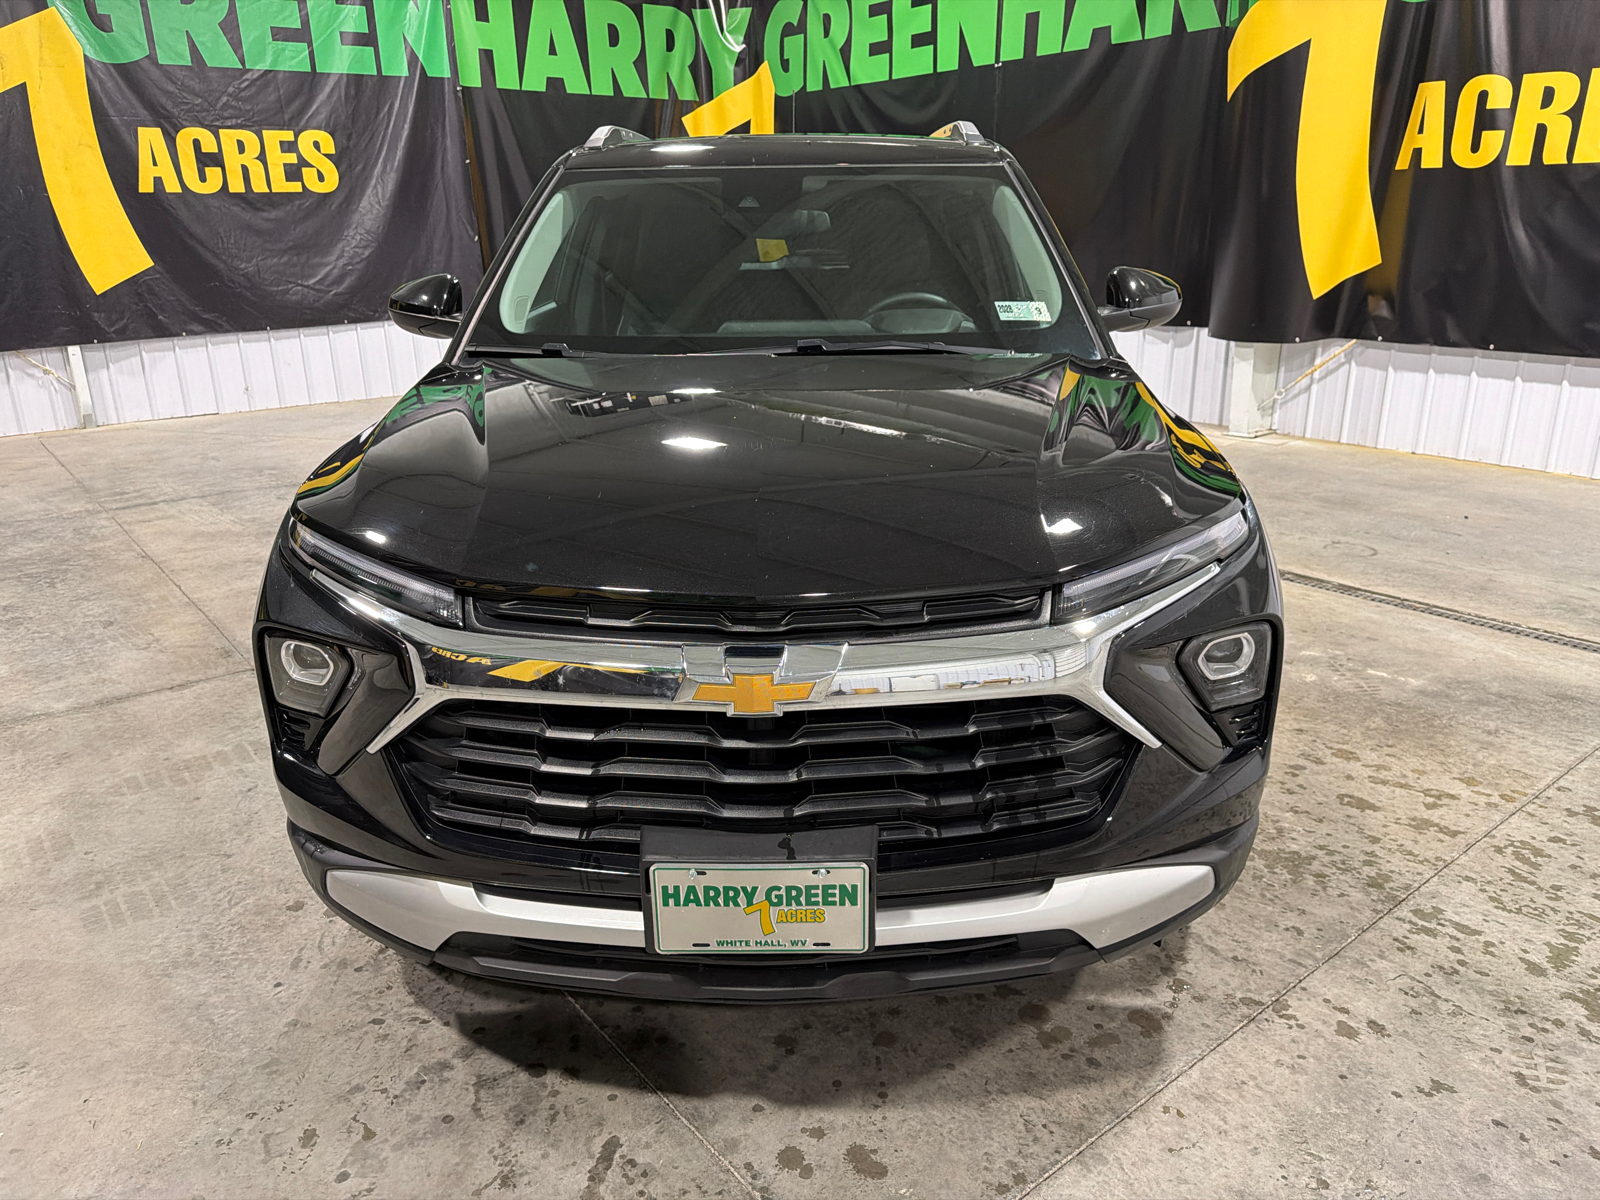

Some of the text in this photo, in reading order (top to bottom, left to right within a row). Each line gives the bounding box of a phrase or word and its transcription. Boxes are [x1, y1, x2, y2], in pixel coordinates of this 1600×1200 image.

[450, 0, 753, 101] HARRY
[763, 0, 998, 97] GREEN
[0, 6, 340, 296] 7 ACRES
[1226, 0, 1389, 299] 7
[661, 884, 859, 907] HARRY GREEN
[742, 899, 825, 936] 7 ACRES
[715, 939, 807, 948] WHITE HALL, WV
